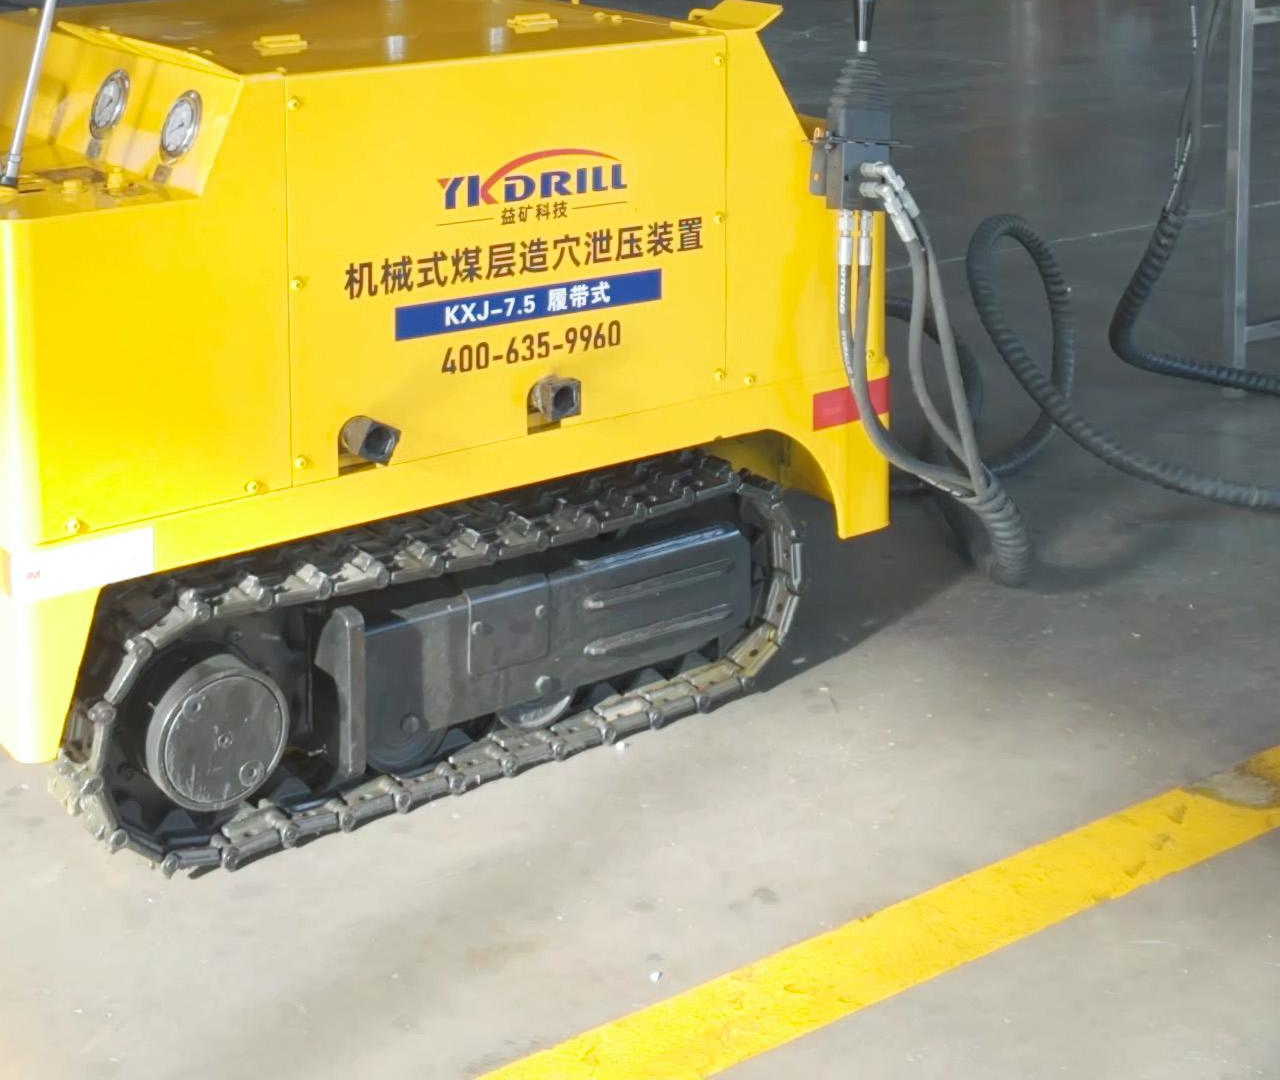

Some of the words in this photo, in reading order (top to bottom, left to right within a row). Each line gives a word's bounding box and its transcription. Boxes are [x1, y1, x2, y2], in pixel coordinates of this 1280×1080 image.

[501, 200, 568, 226] 益矿科技
[344, 216, 704, 300] 机械式煤层造穴泄压装置
[444, 293, 537, 327] KXJ-7.5
[546, 281, 611, 313] 履带式
[441, 319, 621, 376] 400-635-9960
